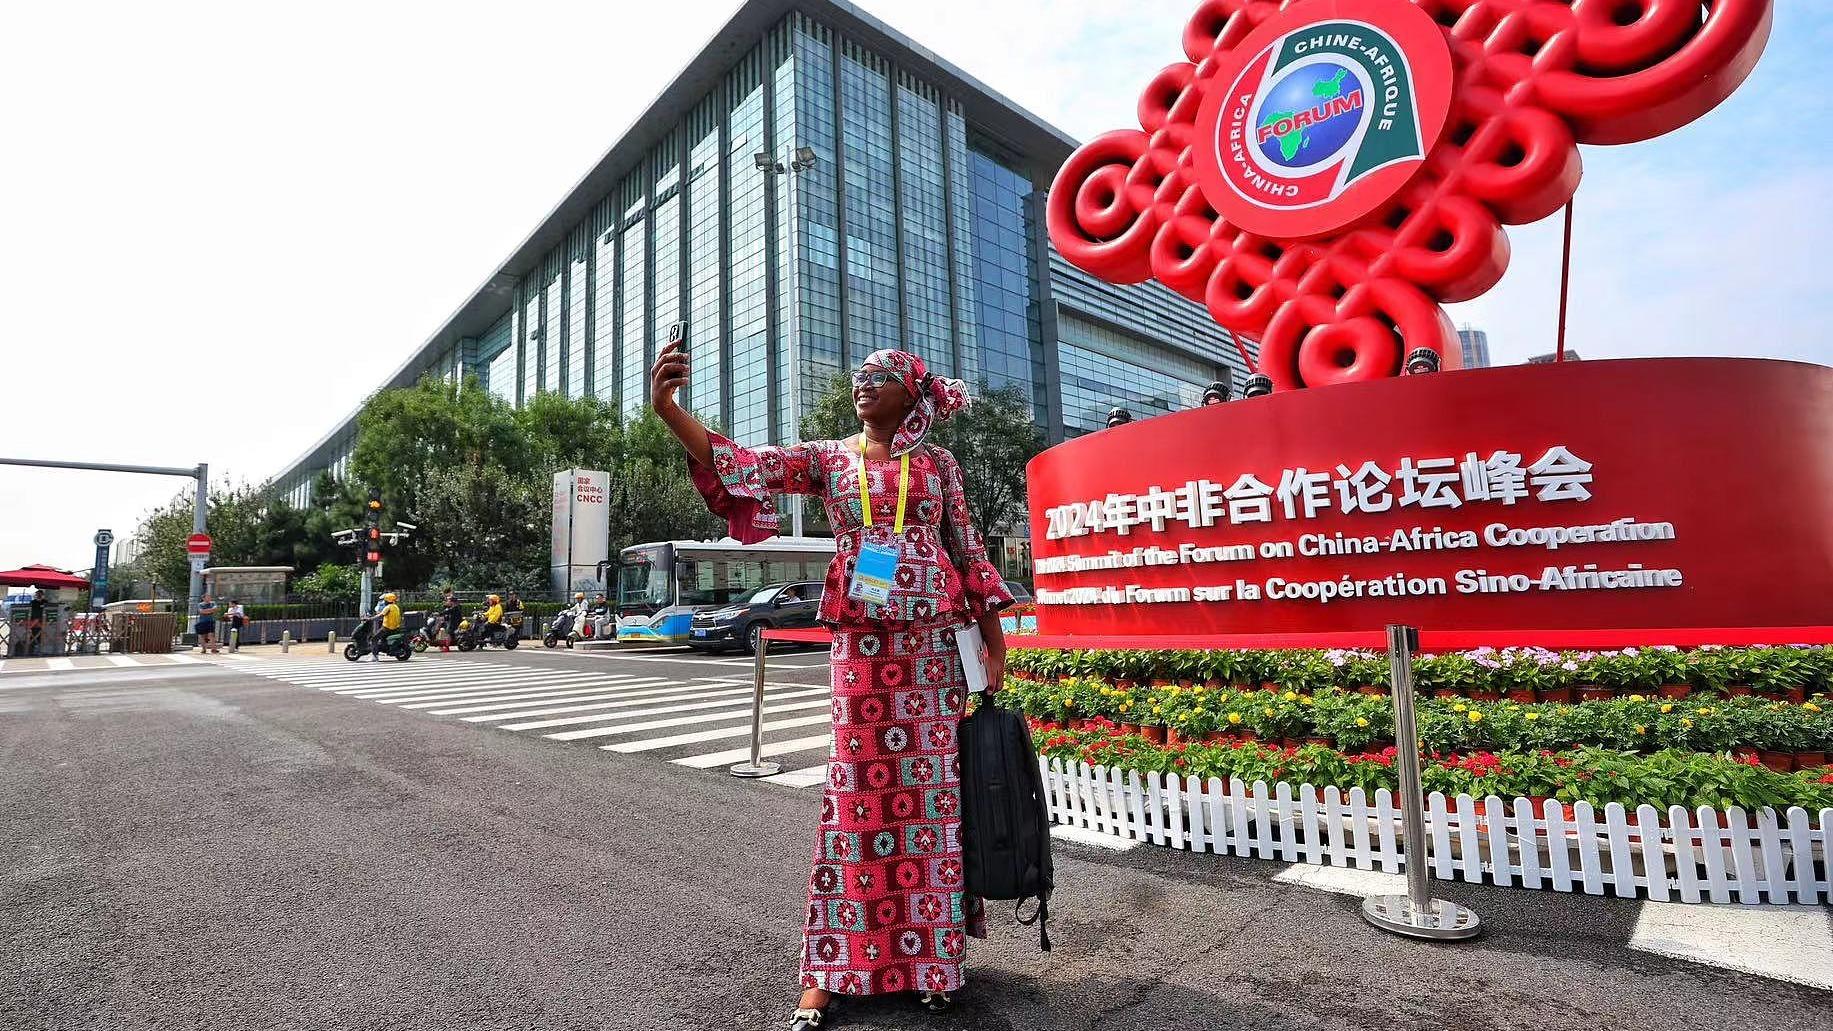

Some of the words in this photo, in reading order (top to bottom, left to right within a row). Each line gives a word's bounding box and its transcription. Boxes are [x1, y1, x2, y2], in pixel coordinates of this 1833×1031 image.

[1294, 34, 1399, 131] CHINE-AFRIQUE
[1257, 89, 1363, 144] FORUM
[1230, 93, 1299, 197] CHINA-AFRICA
[576, 494, 603, 504] CNCC
[1045, 446, 1593, 540] 2024年中非合作论坛峰会
[1143, 545, 1179, 566] the
[1179, 543, 1255, 565] Forum
[1259, 540, 1294, 558] on
[1298, 526, 1478, 556] China-Africa
[1484, 517, 1676, 549] Cooperation
[1125, 584, 1190, 604] Forum
[1193, 584, 1233, 601] sur
[1235, 579, 1261, 601] la
[1265, 572, 1447, 603] Coopération
[1454, 563, 1684, 594] Sino-Africaine
